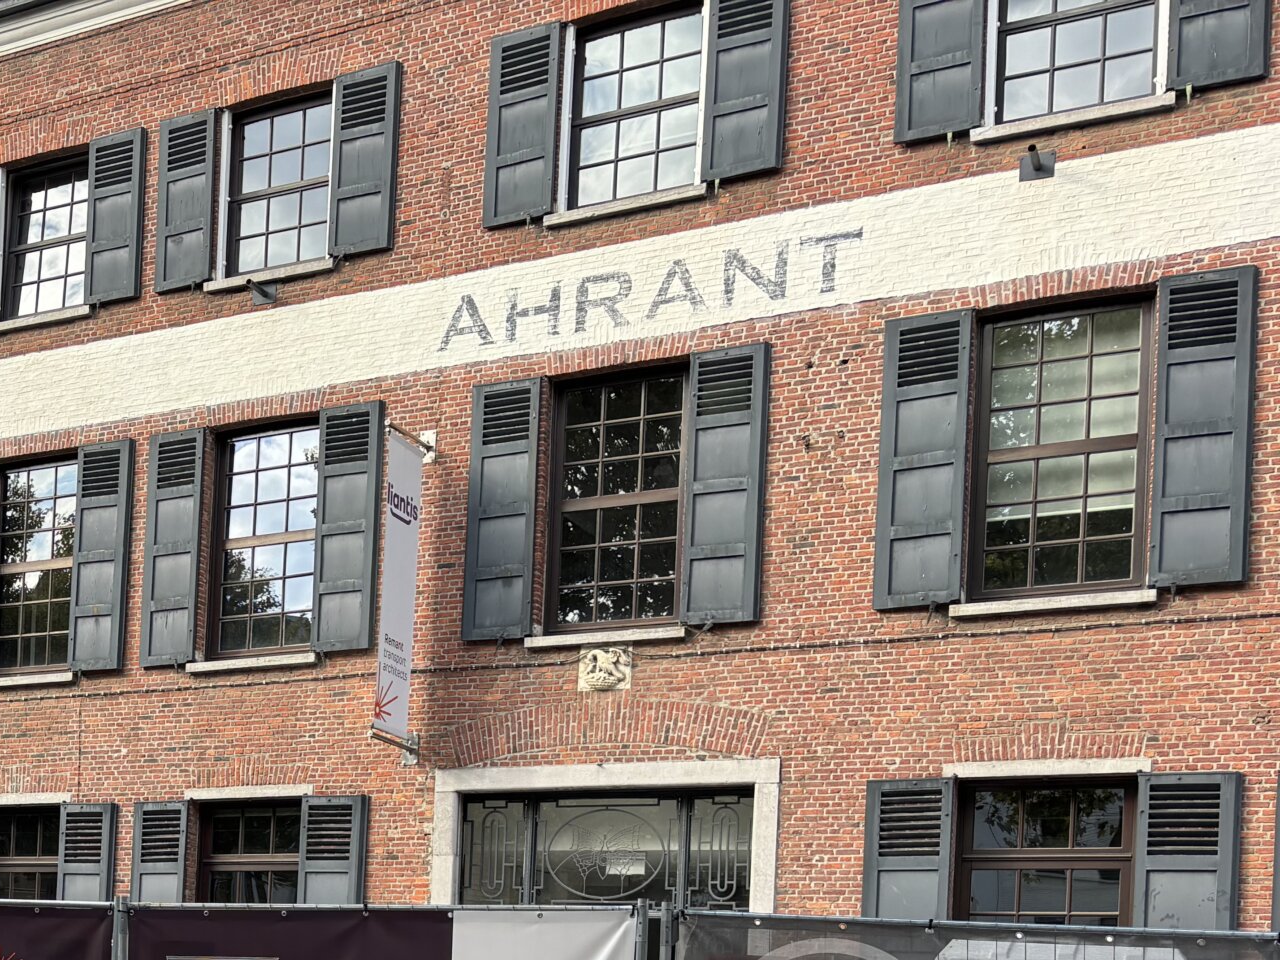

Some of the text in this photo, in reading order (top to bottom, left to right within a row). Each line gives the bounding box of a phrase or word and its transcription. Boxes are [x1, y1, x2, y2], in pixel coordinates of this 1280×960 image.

[437, 227, 864, 352] AHRANT
[388, 482, 419, 521] liantis
[384, 633, 405, 652] Remant
[383, 650, 407, 669] transport
[382, 662, 408, 682] architects
